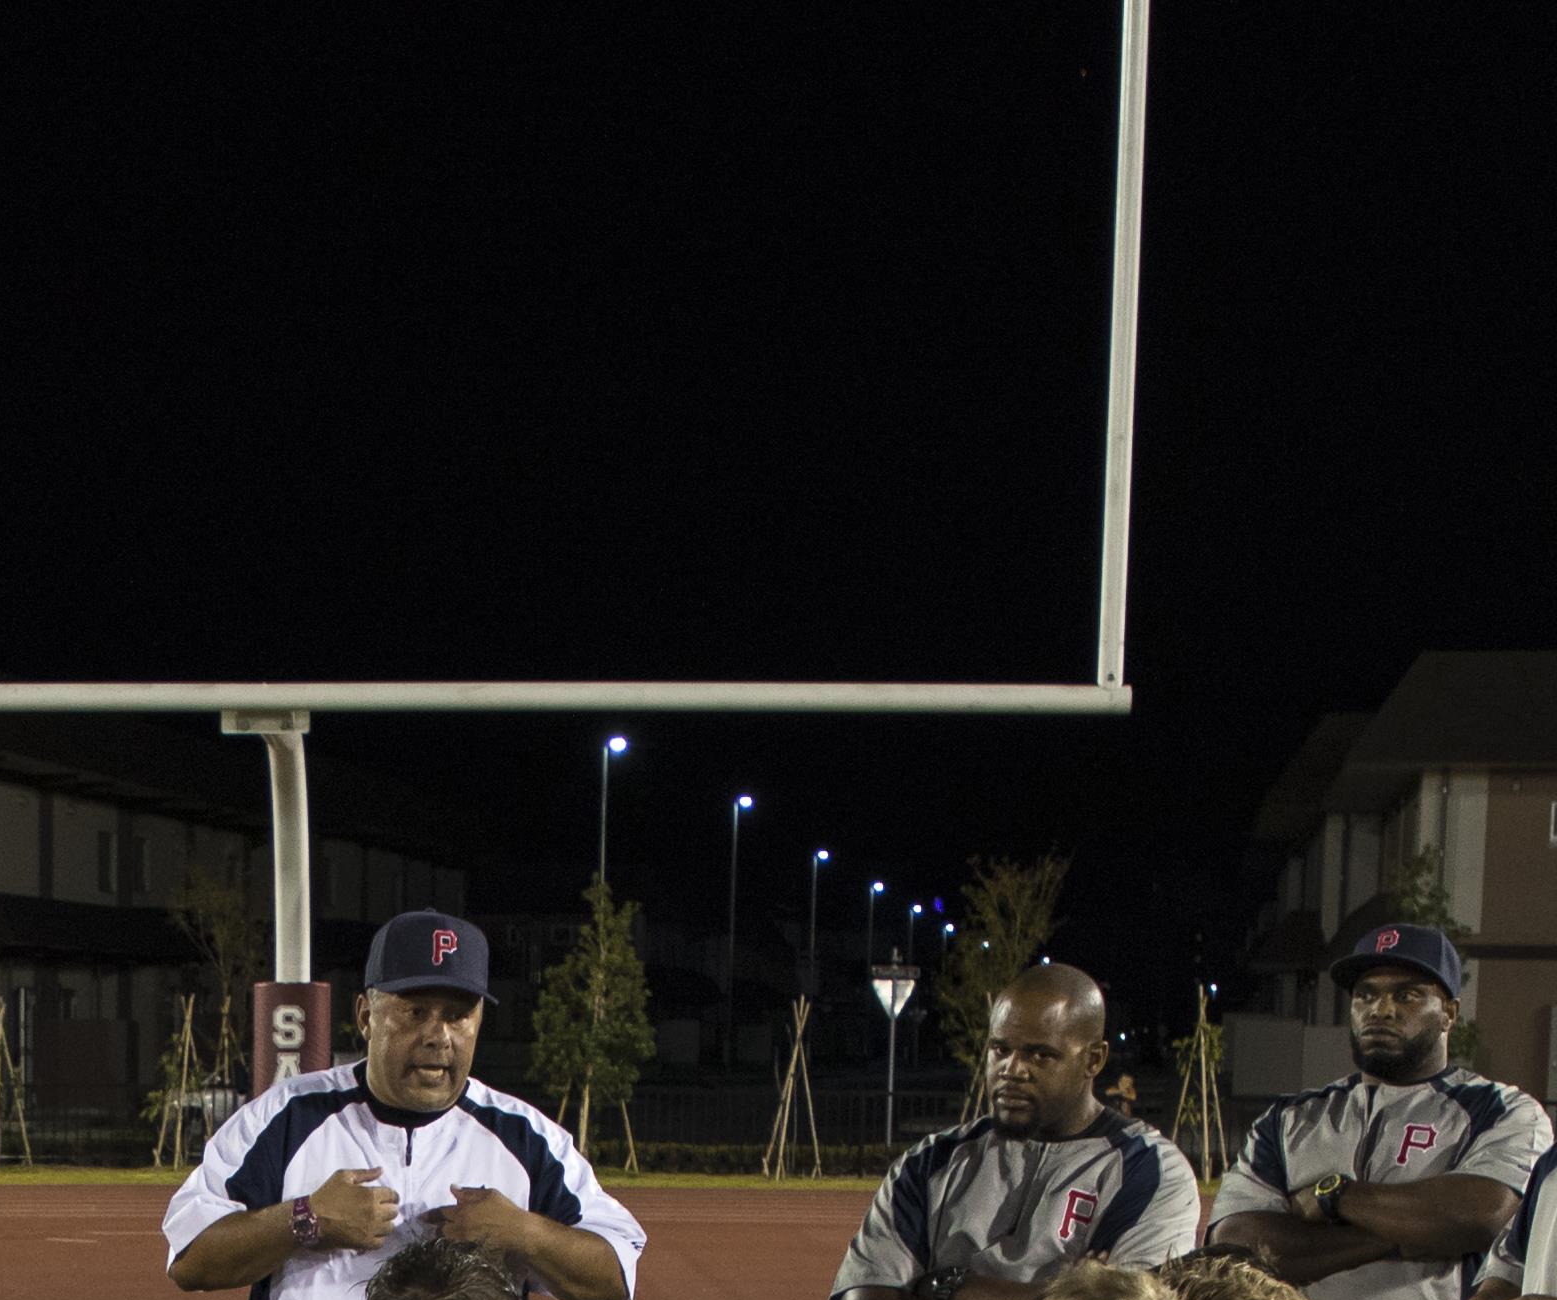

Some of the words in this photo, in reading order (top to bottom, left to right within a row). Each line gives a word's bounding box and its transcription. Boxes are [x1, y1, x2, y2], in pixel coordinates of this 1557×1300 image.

[431, 929, 458, 965] P
[1375, 928, 1400, 954] P
[1397, 1123, 1437, 1165] P
[1058, 1188, 1099, 1240] P
